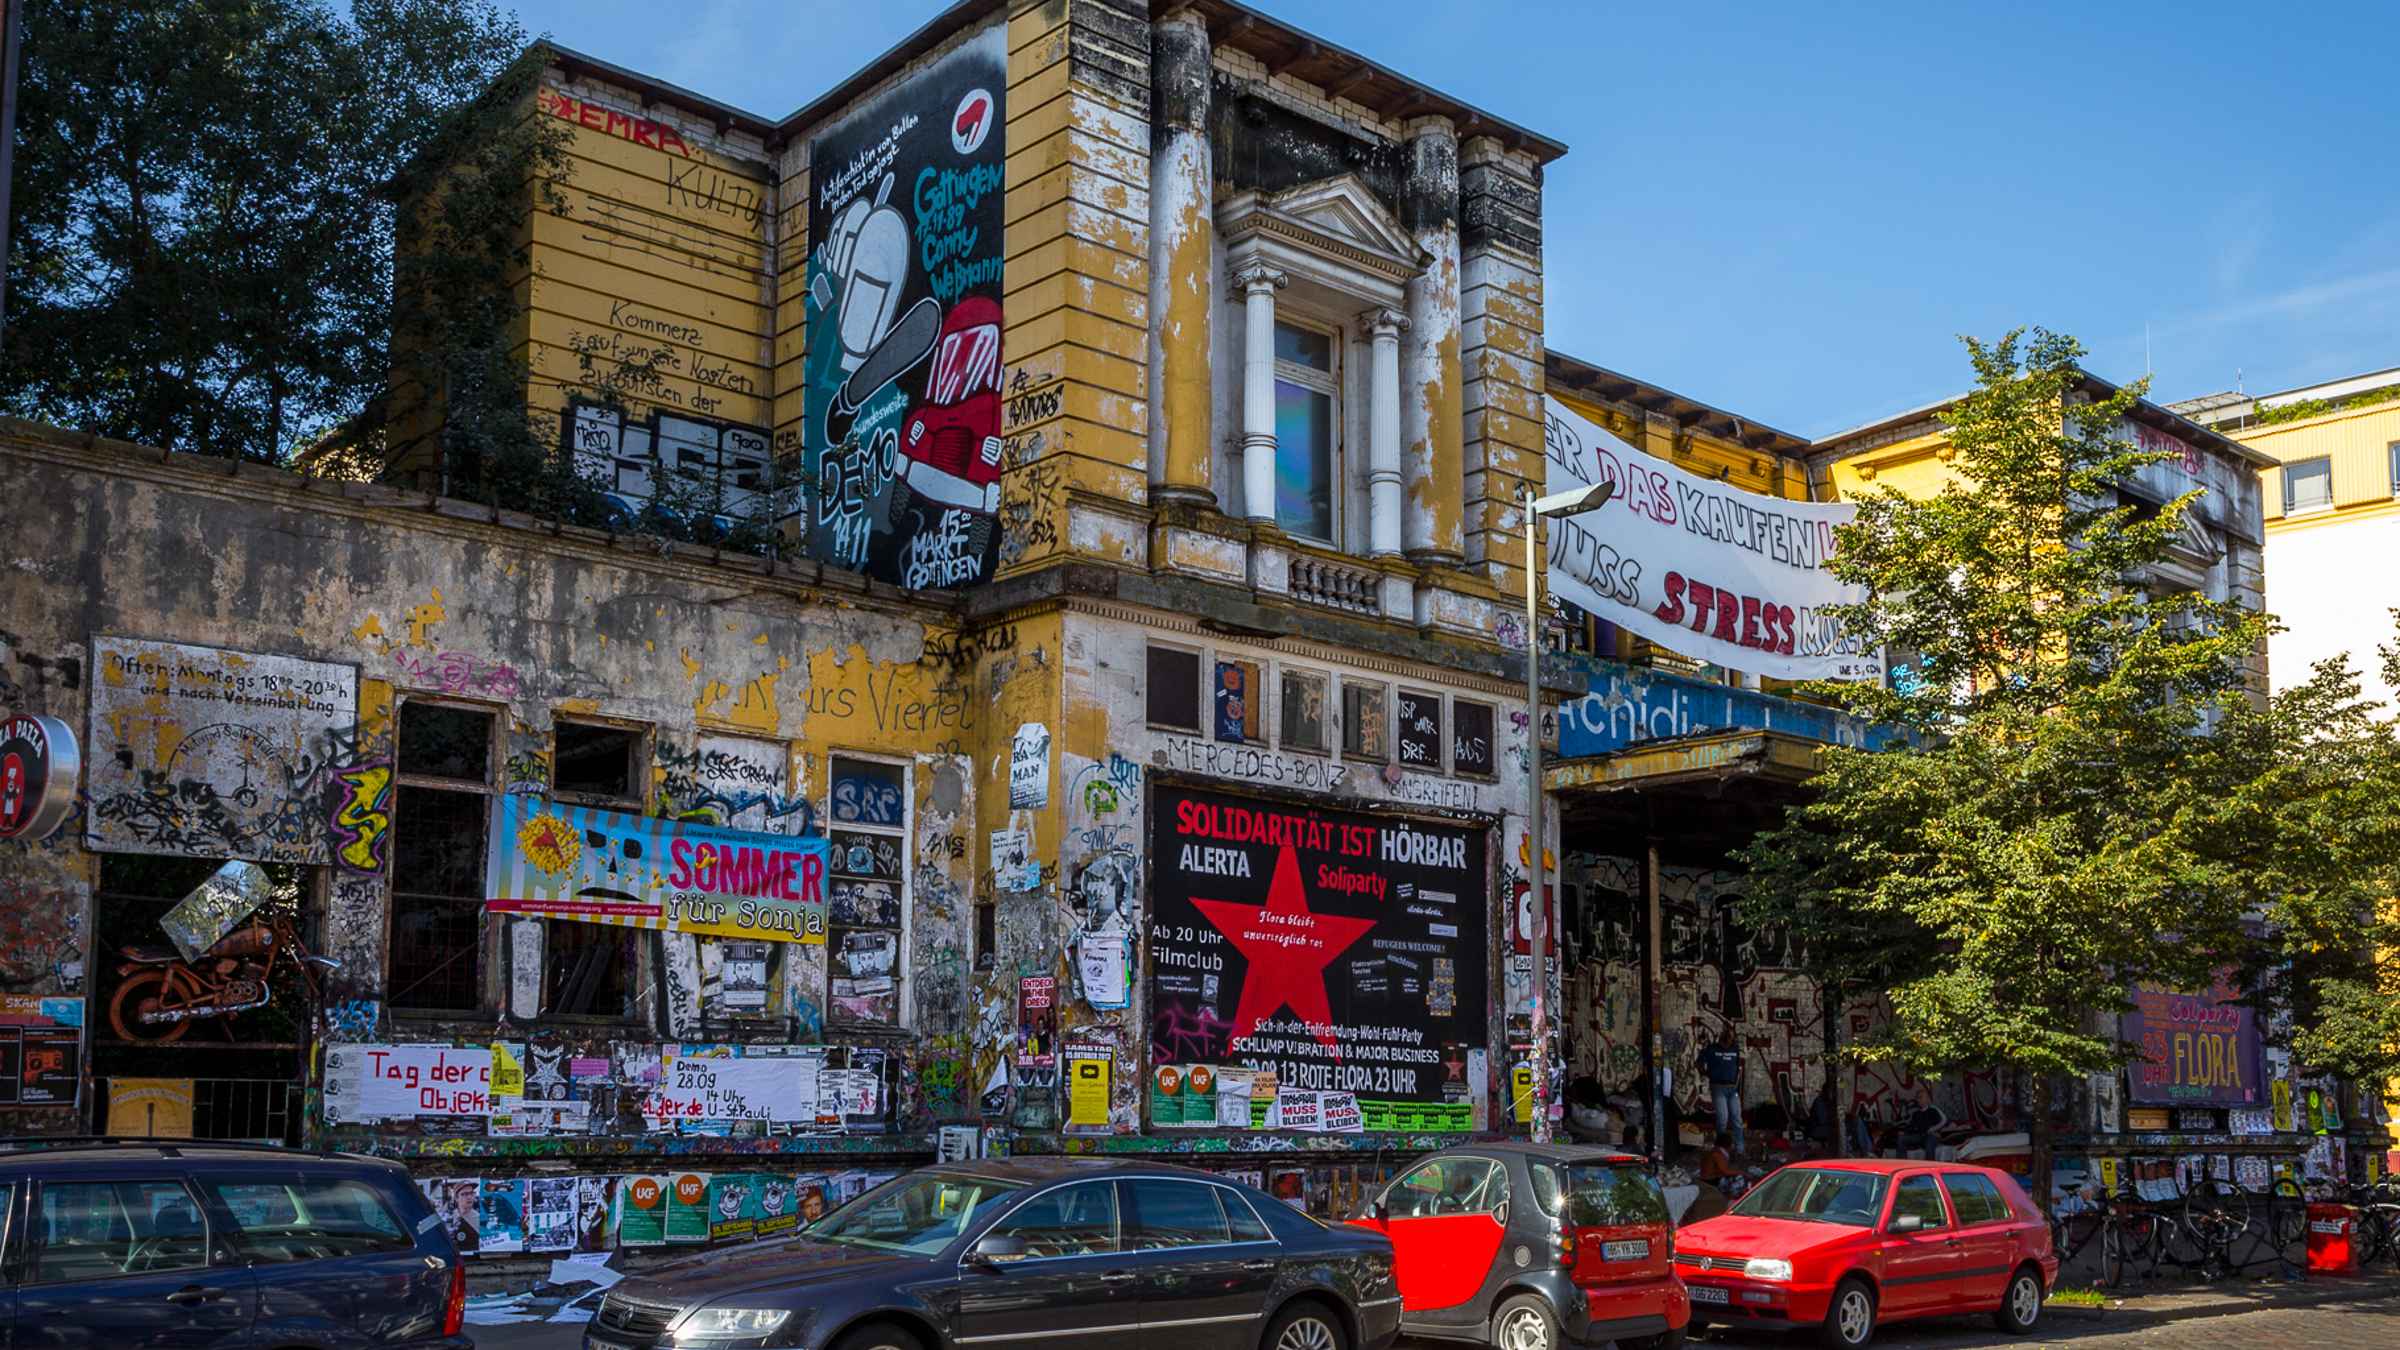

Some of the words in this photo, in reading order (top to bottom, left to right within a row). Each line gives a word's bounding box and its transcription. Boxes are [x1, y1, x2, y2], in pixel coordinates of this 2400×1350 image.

[608, 300, 702, 346] Kommerz
[818, 426, 898, 526] DEMO
[1595, 446, 1678, 525] DAS
[1676, 480, 1815, 570] KAUFEN
[911, 529, 969, 563] MARKT
[1655, 570, 1797, 657] STRESS
[15, 719, 45, 759] PAZZA
[1012, 764, 1041, 784] MAN
[1175, 798, 1333, 853] SOLIDARITÄT
[1339, 822, 1377, 858] IST
[1379, 821, 1468, 871] HÖRBAR
[667, 837, 824, 904] SOMMER
[1178, 842, 1252, 879] ALERTA
[1317, 862, 1388, 902] Soliparty
[666, 893, 726, 924] für
[736, 900, 825, 939] Sonja
[1259, 911, 1286, 924] Flora
[1286, 913, 1316, 929] bleibt
[1151, 925, 1171, 940] Ab
[1175, 926, 1194, 942] 20
[1199, 929, 1224, 945] Uhr
[676, 1060, 708, 1073] Demo
[1231, 1036, 1286, 1054] SCHLUMP
[1344, 1046, 1354, 1059] &
[1355, 1046, 1390, 1061] MAJOR
[1390, 1048, 1441, 1064] BUSINESS
[2174, 1031, 2242, 1088] FLORA
[366, 1051, 420, 1090] Tag
[430, 1052, 473, 1084] der
[676, 1072, 717, 1090] 28.09
[1299, 1062, 1333, 1091] ROTE
[1334, 1065, 1373, 1093] FLORA
[1374, 1066, 1390, 1093] 23
[1391, 1067, 1418, 1095] UHR
[706, 1090, 719, 1102] 14
[722, 1089, 746, 1104] Uhr
[1281, 1104, 1318, 1117] MUSS
[636, 1187, 656, 1200] UKF
[681, 1183, 700, 1195] UKF
